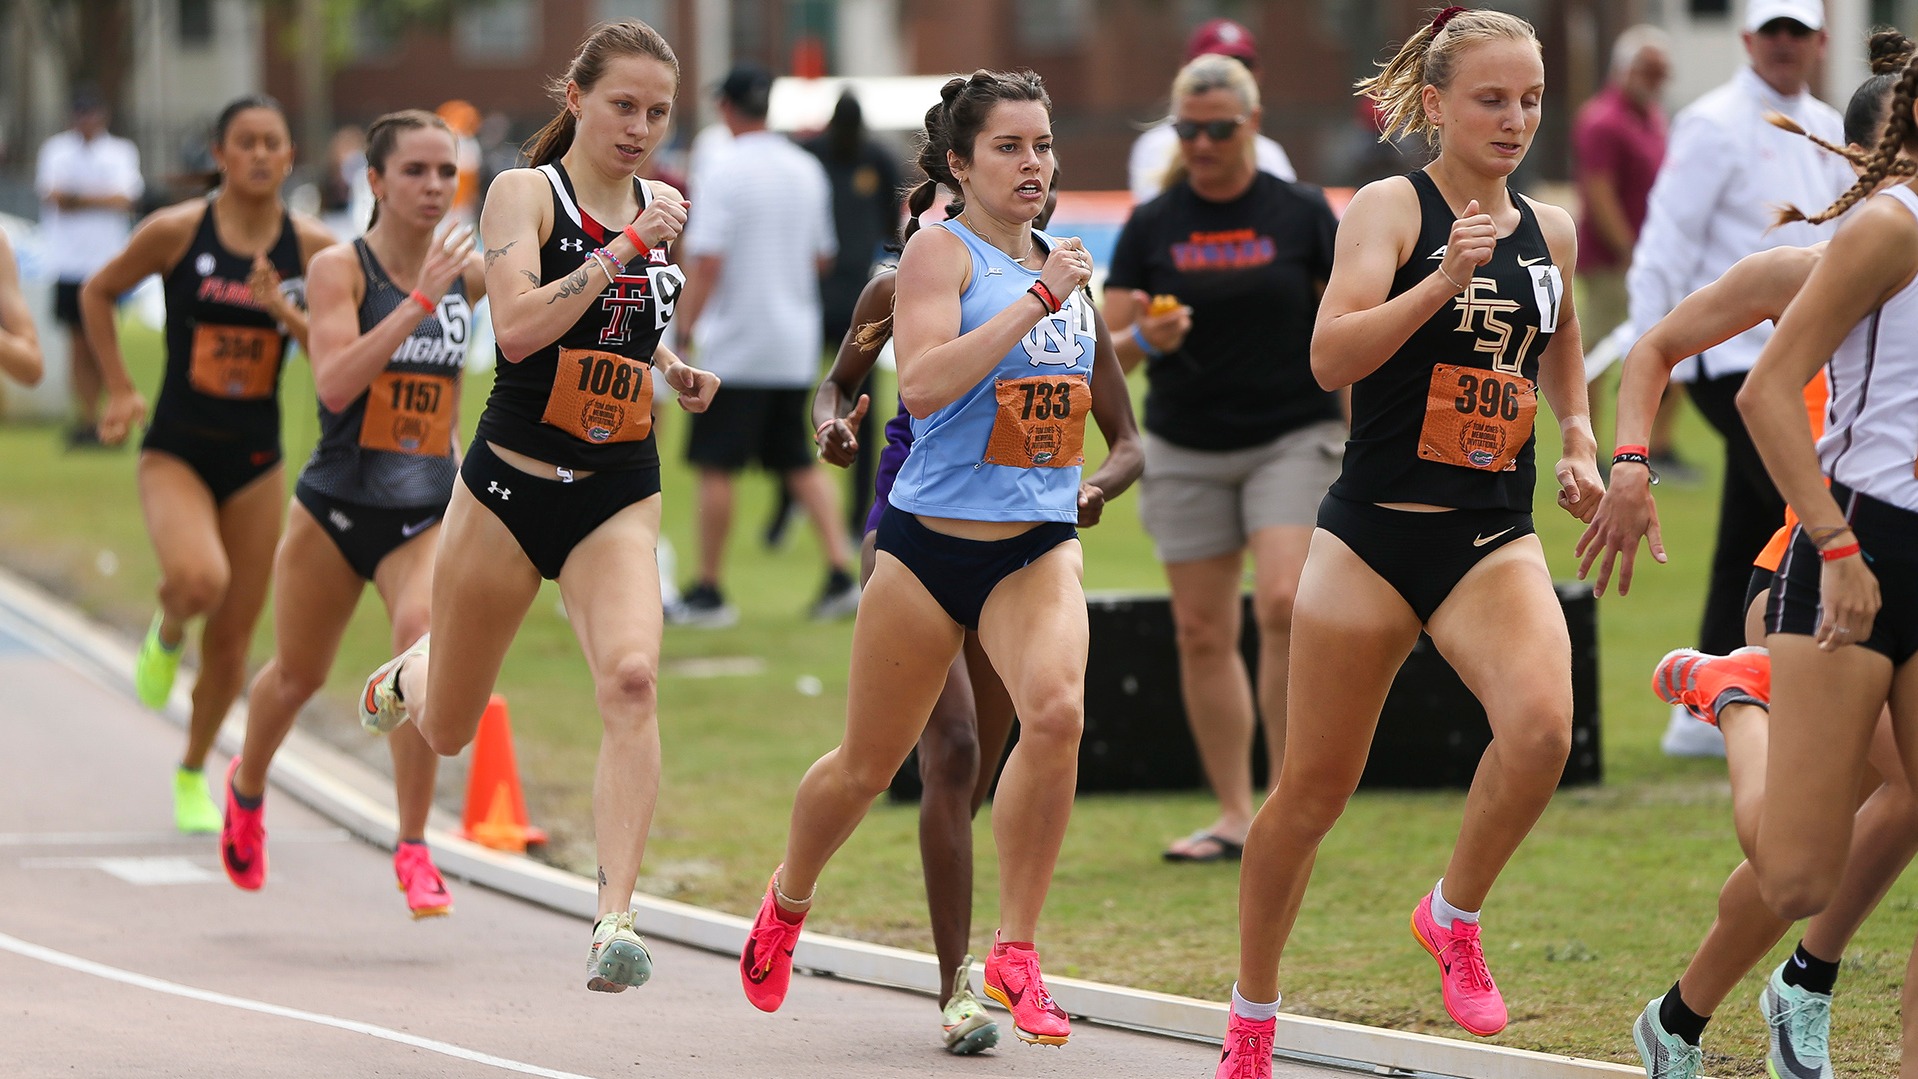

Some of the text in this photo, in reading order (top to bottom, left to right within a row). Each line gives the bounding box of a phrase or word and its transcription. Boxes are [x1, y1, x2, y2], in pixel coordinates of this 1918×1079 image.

[655, 271, 681, 323] 9
[445, 302, 466, 344] 5
[1453, 277, 1539, 378] FSU
[391, 381, 441, 414] 1157
[578, 356, 643, 403] 1087
[1019, 382, 1071, 420] 733
[1455, 375, 1519, 421] 396
